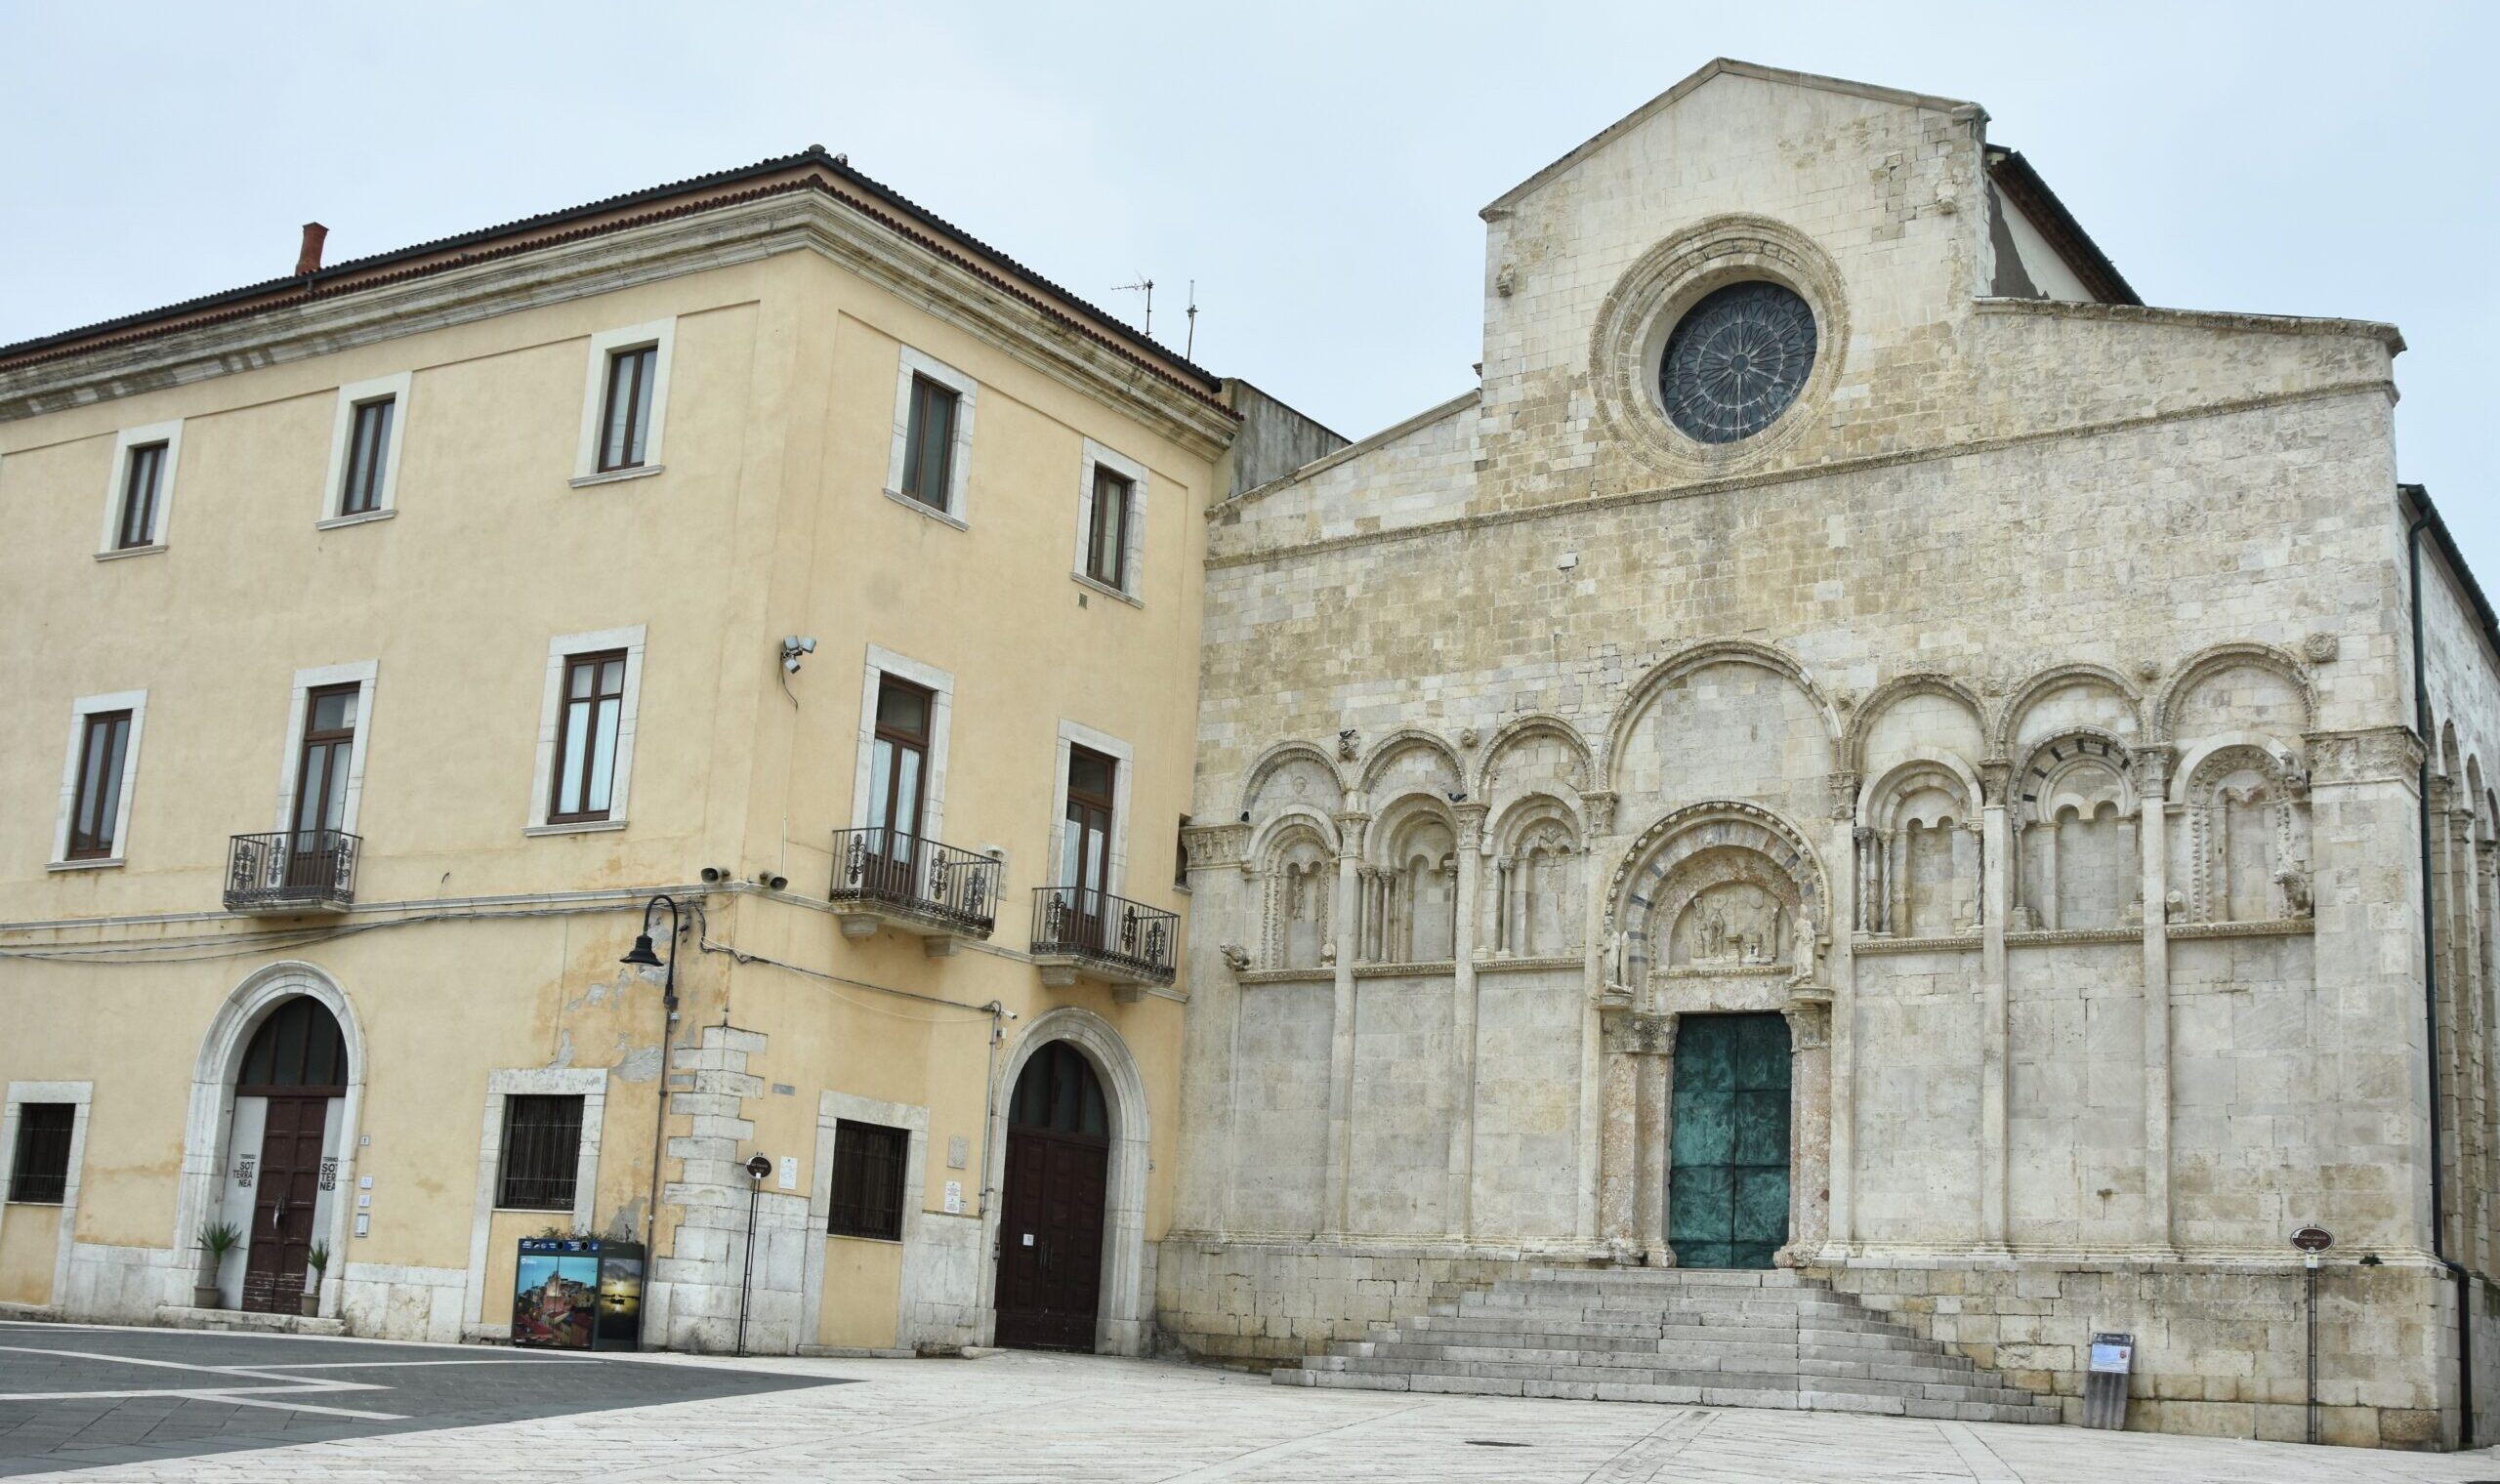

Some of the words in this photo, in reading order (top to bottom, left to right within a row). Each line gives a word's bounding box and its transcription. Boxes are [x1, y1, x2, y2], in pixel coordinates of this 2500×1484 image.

[239, 1162, 255, 1171] SOT
[233, 1170, 253, 1178] TERRA
[320, 1173, 336, 1181] TER
[238, 1178, 252, 1187] NEA
[319, 1181, 336, 1191] NEA
